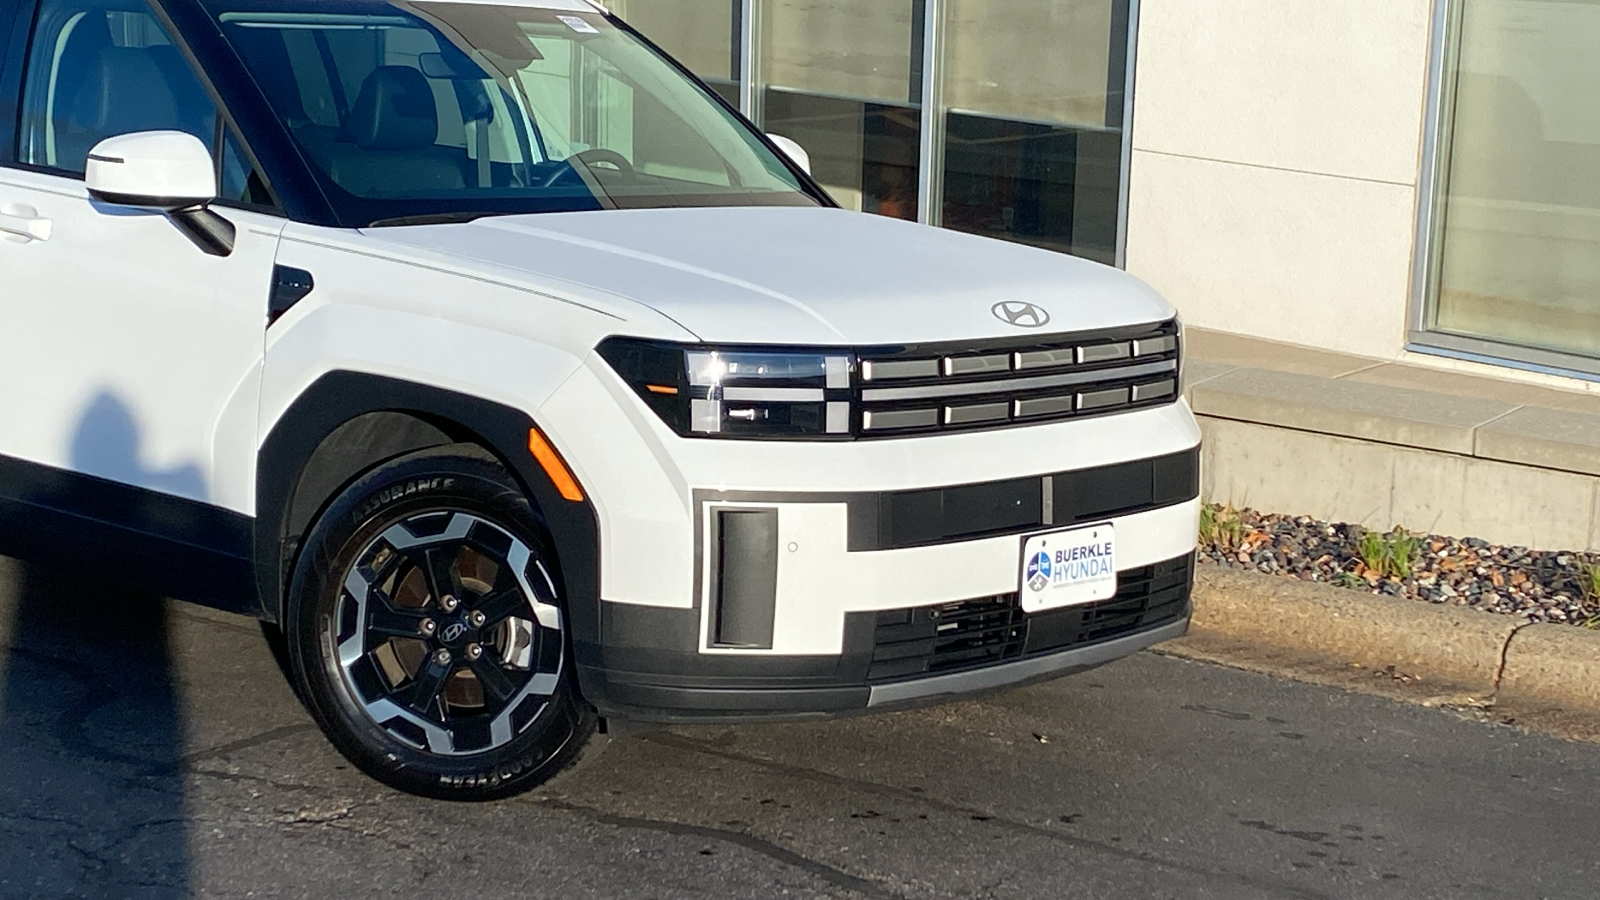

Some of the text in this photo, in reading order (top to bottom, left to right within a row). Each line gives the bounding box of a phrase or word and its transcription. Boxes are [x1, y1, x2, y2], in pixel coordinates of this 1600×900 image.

[351, 477, 455, 524] ASSURANCE
[1055, 542, 1112, 564] BUERKLE
[1053, 557, 1112, 583] HYUNDAI
